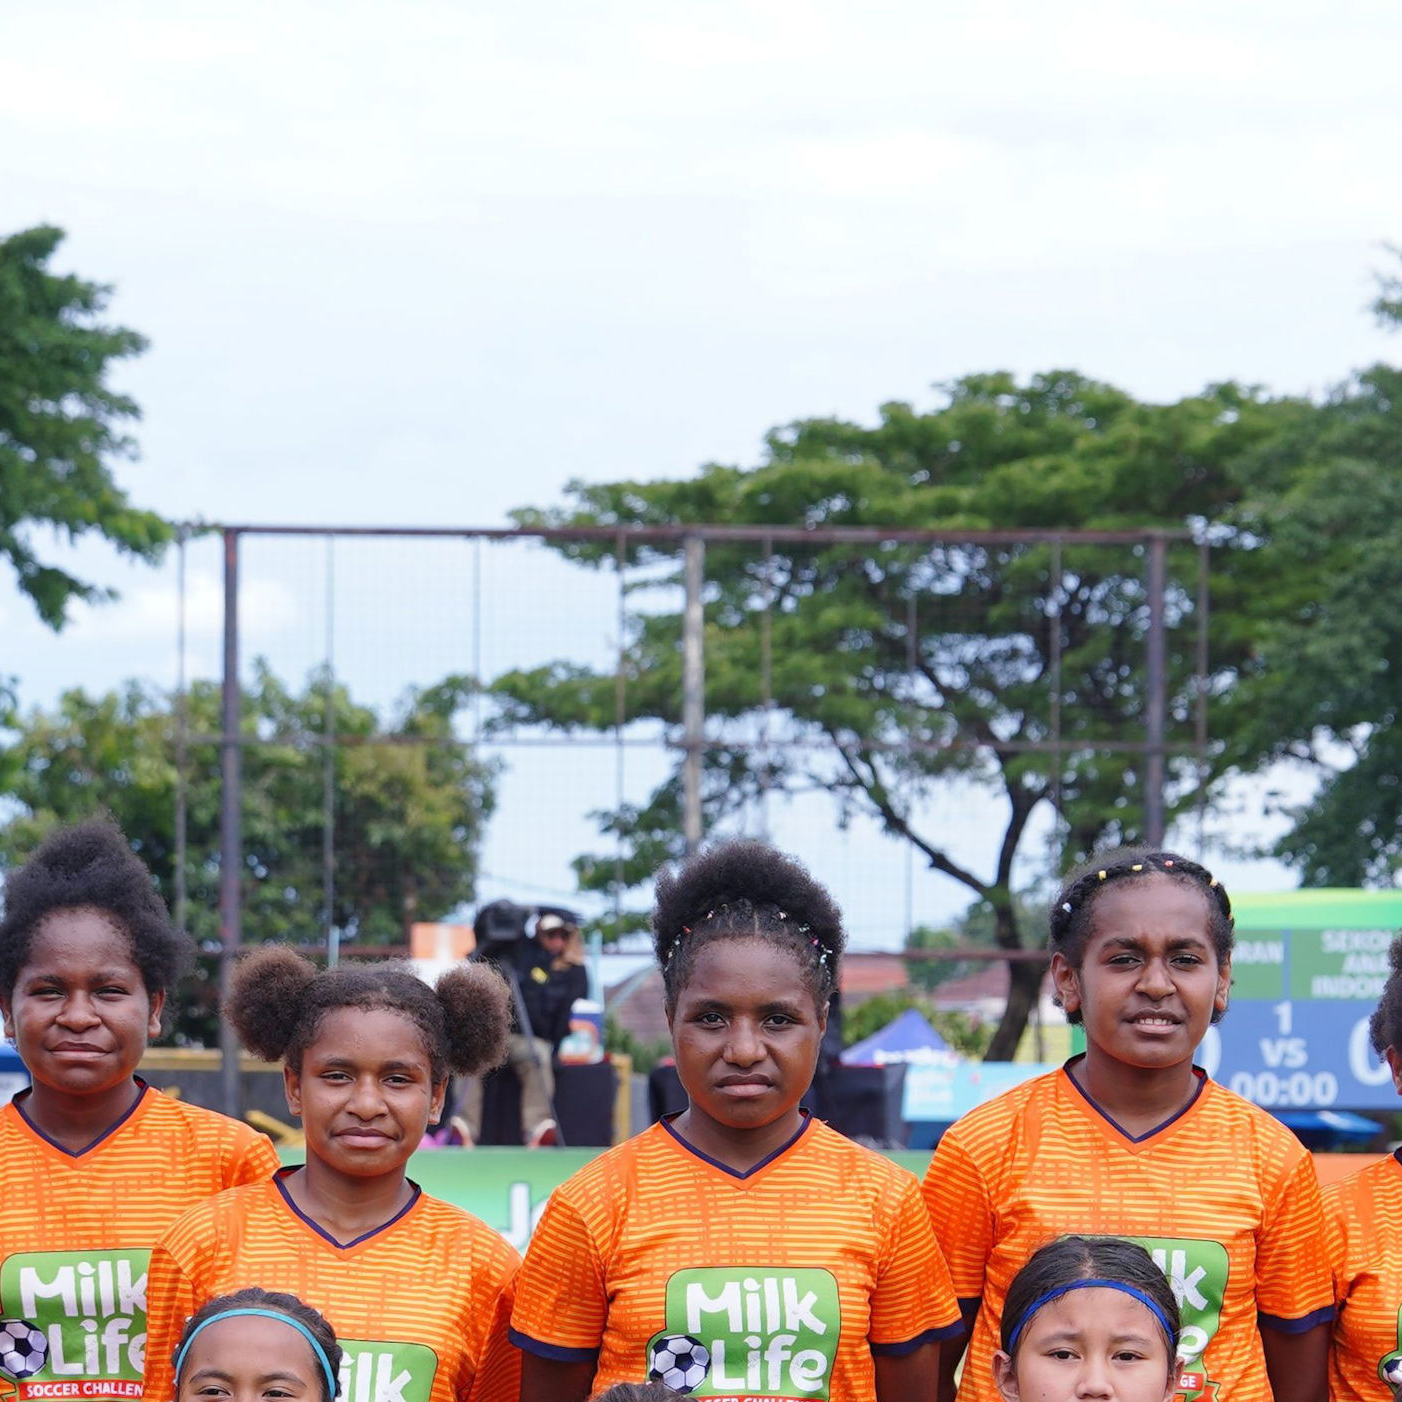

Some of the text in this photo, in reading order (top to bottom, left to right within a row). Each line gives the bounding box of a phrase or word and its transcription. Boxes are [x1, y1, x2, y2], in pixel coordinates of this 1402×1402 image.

[1274, 1001, 1294, 1035] 1
[1231, 1071, 1339, 1106] 00:00
[20, 1259, 147, 1319] Milk
[687, 1277, 827, 1335] Milk
[711, 1334, 827, 1392] Life
[27, 1382, 144, 1398] SOCCER CHALLEN
